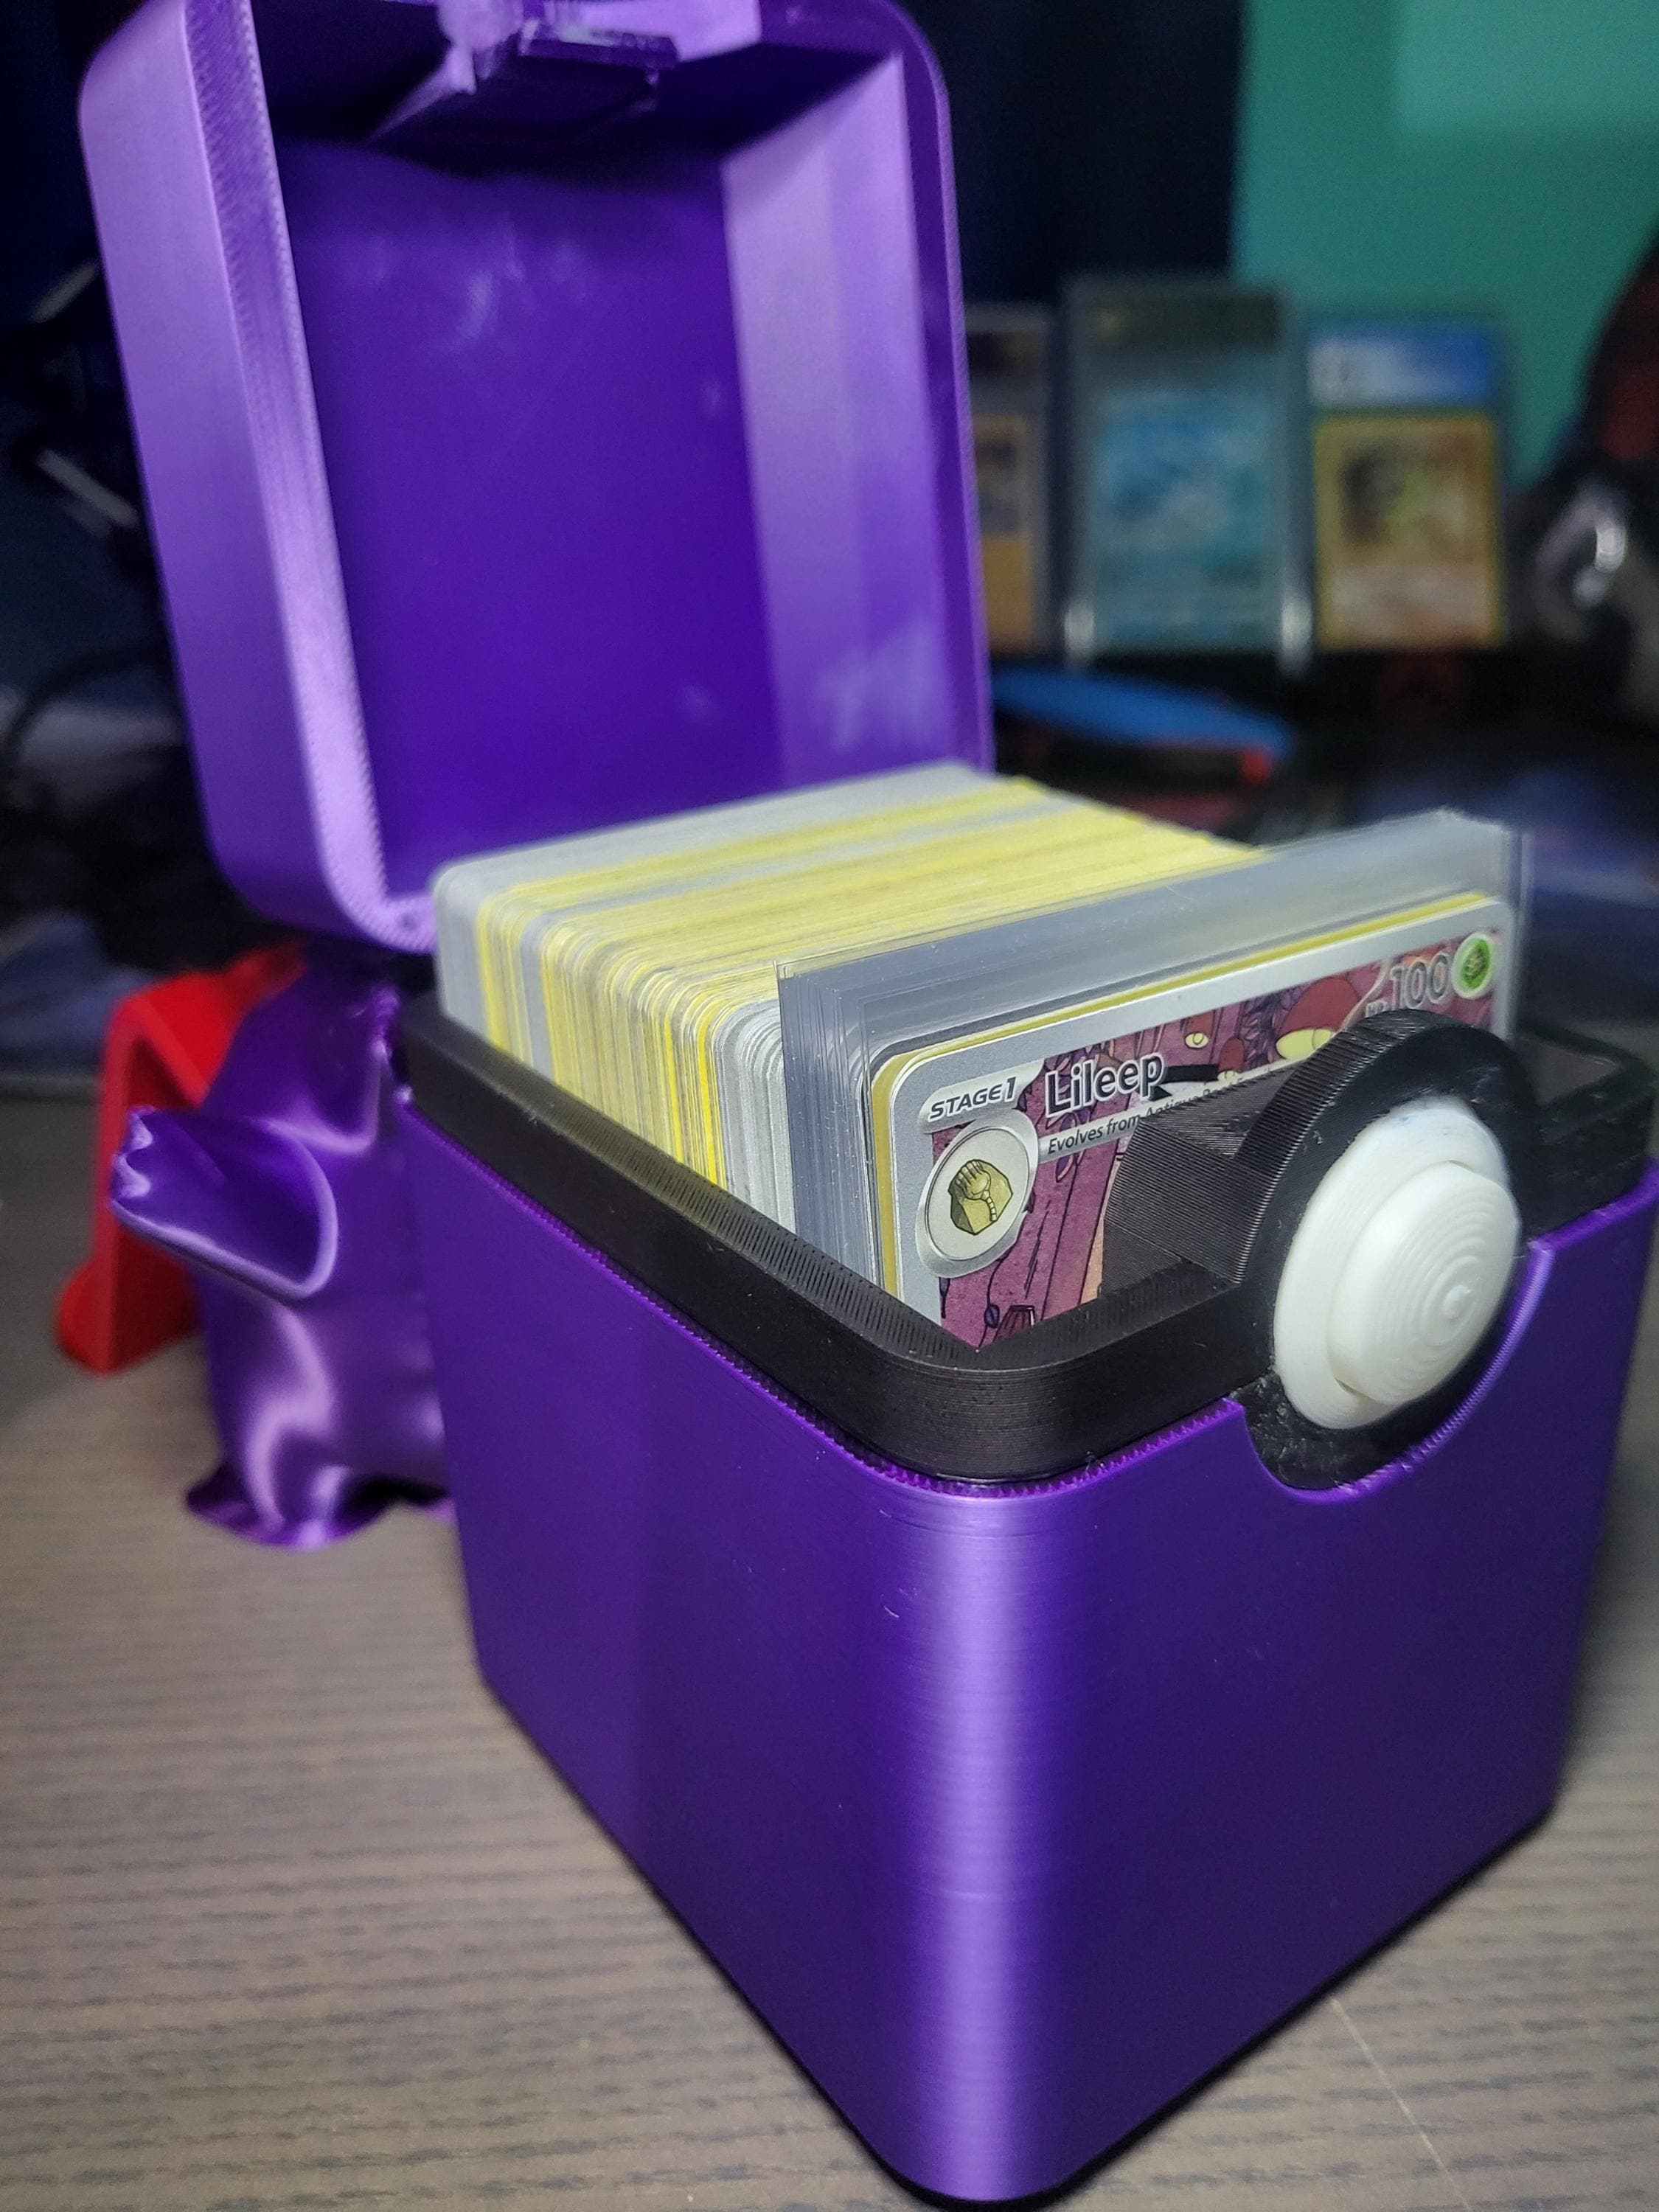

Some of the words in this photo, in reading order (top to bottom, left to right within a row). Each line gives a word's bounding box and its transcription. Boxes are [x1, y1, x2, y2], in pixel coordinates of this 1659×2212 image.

[1389, 953, 1449, 1009] 100
[1045, 1053, 1164, 1118] Lileep
[1048, 1127, 1104, 1155] Evolves
[1106, 1114, 1140, 1138] from
